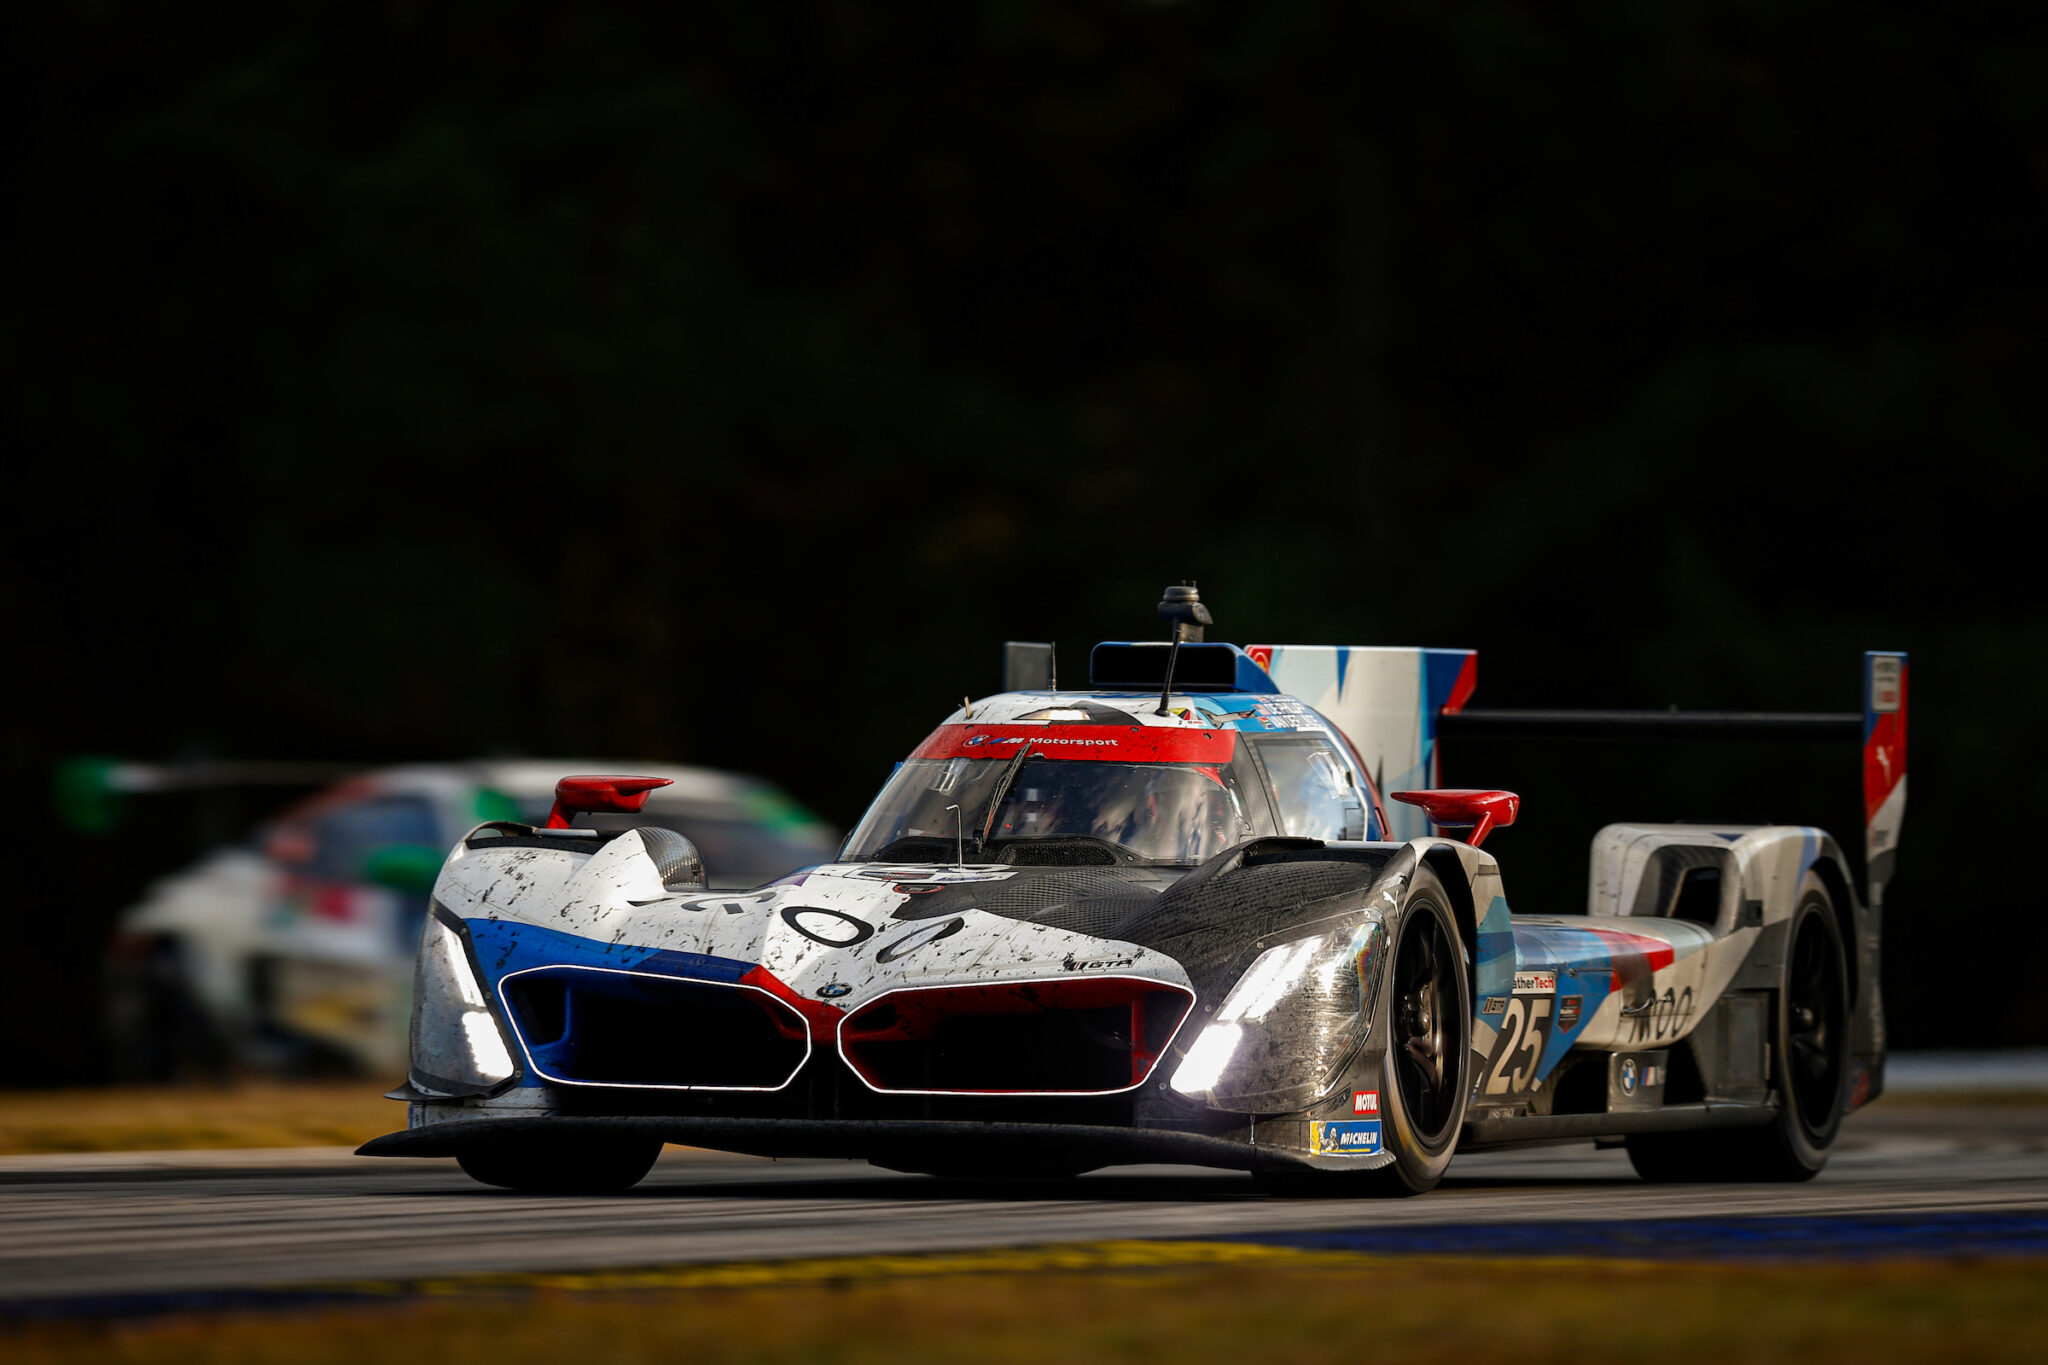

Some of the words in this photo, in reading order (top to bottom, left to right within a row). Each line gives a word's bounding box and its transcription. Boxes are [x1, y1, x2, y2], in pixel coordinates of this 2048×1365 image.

[1029, 737, 1119, 747] Motorsport
[1485, 997, 1552, 1095] 25
[1354, 1093, 1378, 1111] MOTUL
[1340, 1131, 1378, 1145] MICHELIN
